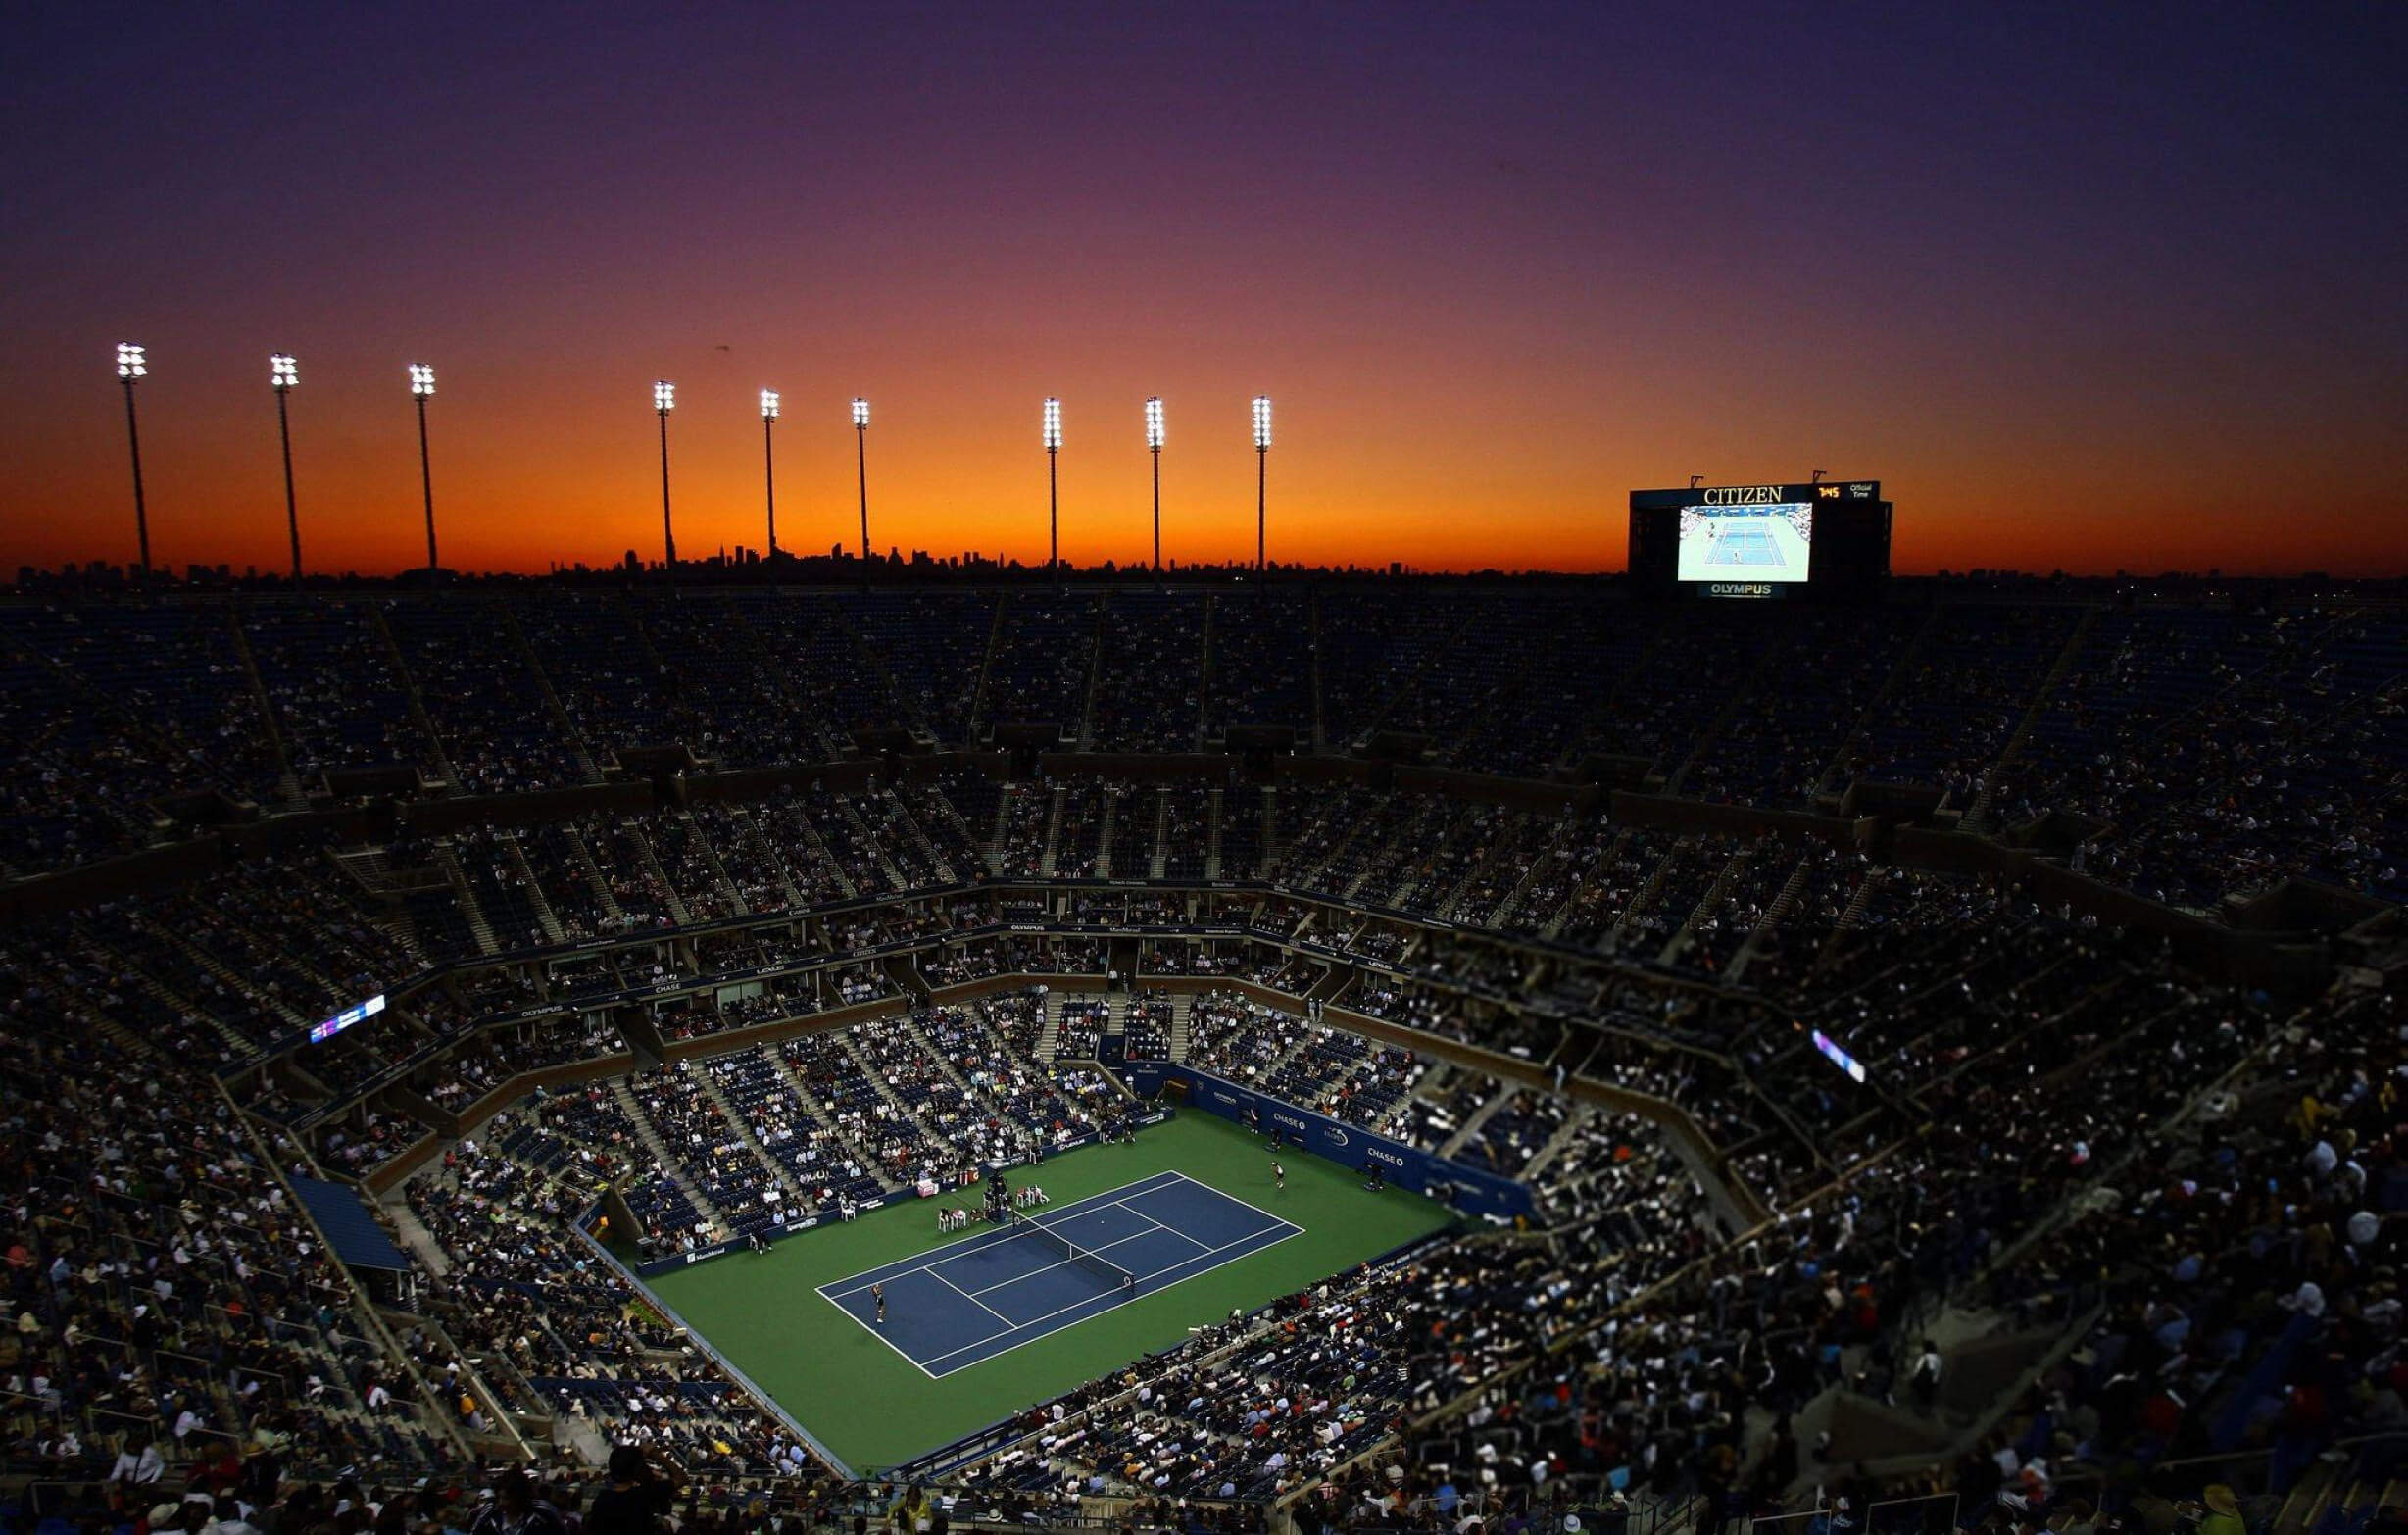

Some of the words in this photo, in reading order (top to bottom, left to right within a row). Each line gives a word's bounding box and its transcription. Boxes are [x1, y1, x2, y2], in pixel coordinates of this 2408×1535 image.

[1703, 486, 1783, 505] CITIZEN
[1710, 584, 1772, 594] OLYMPUS
[521, 1005, 563, 1017] OLYMPUS
[1274, 1113, 1299, 1128] CHASE
[1367, 1147, 1397, 1164] CHASE
